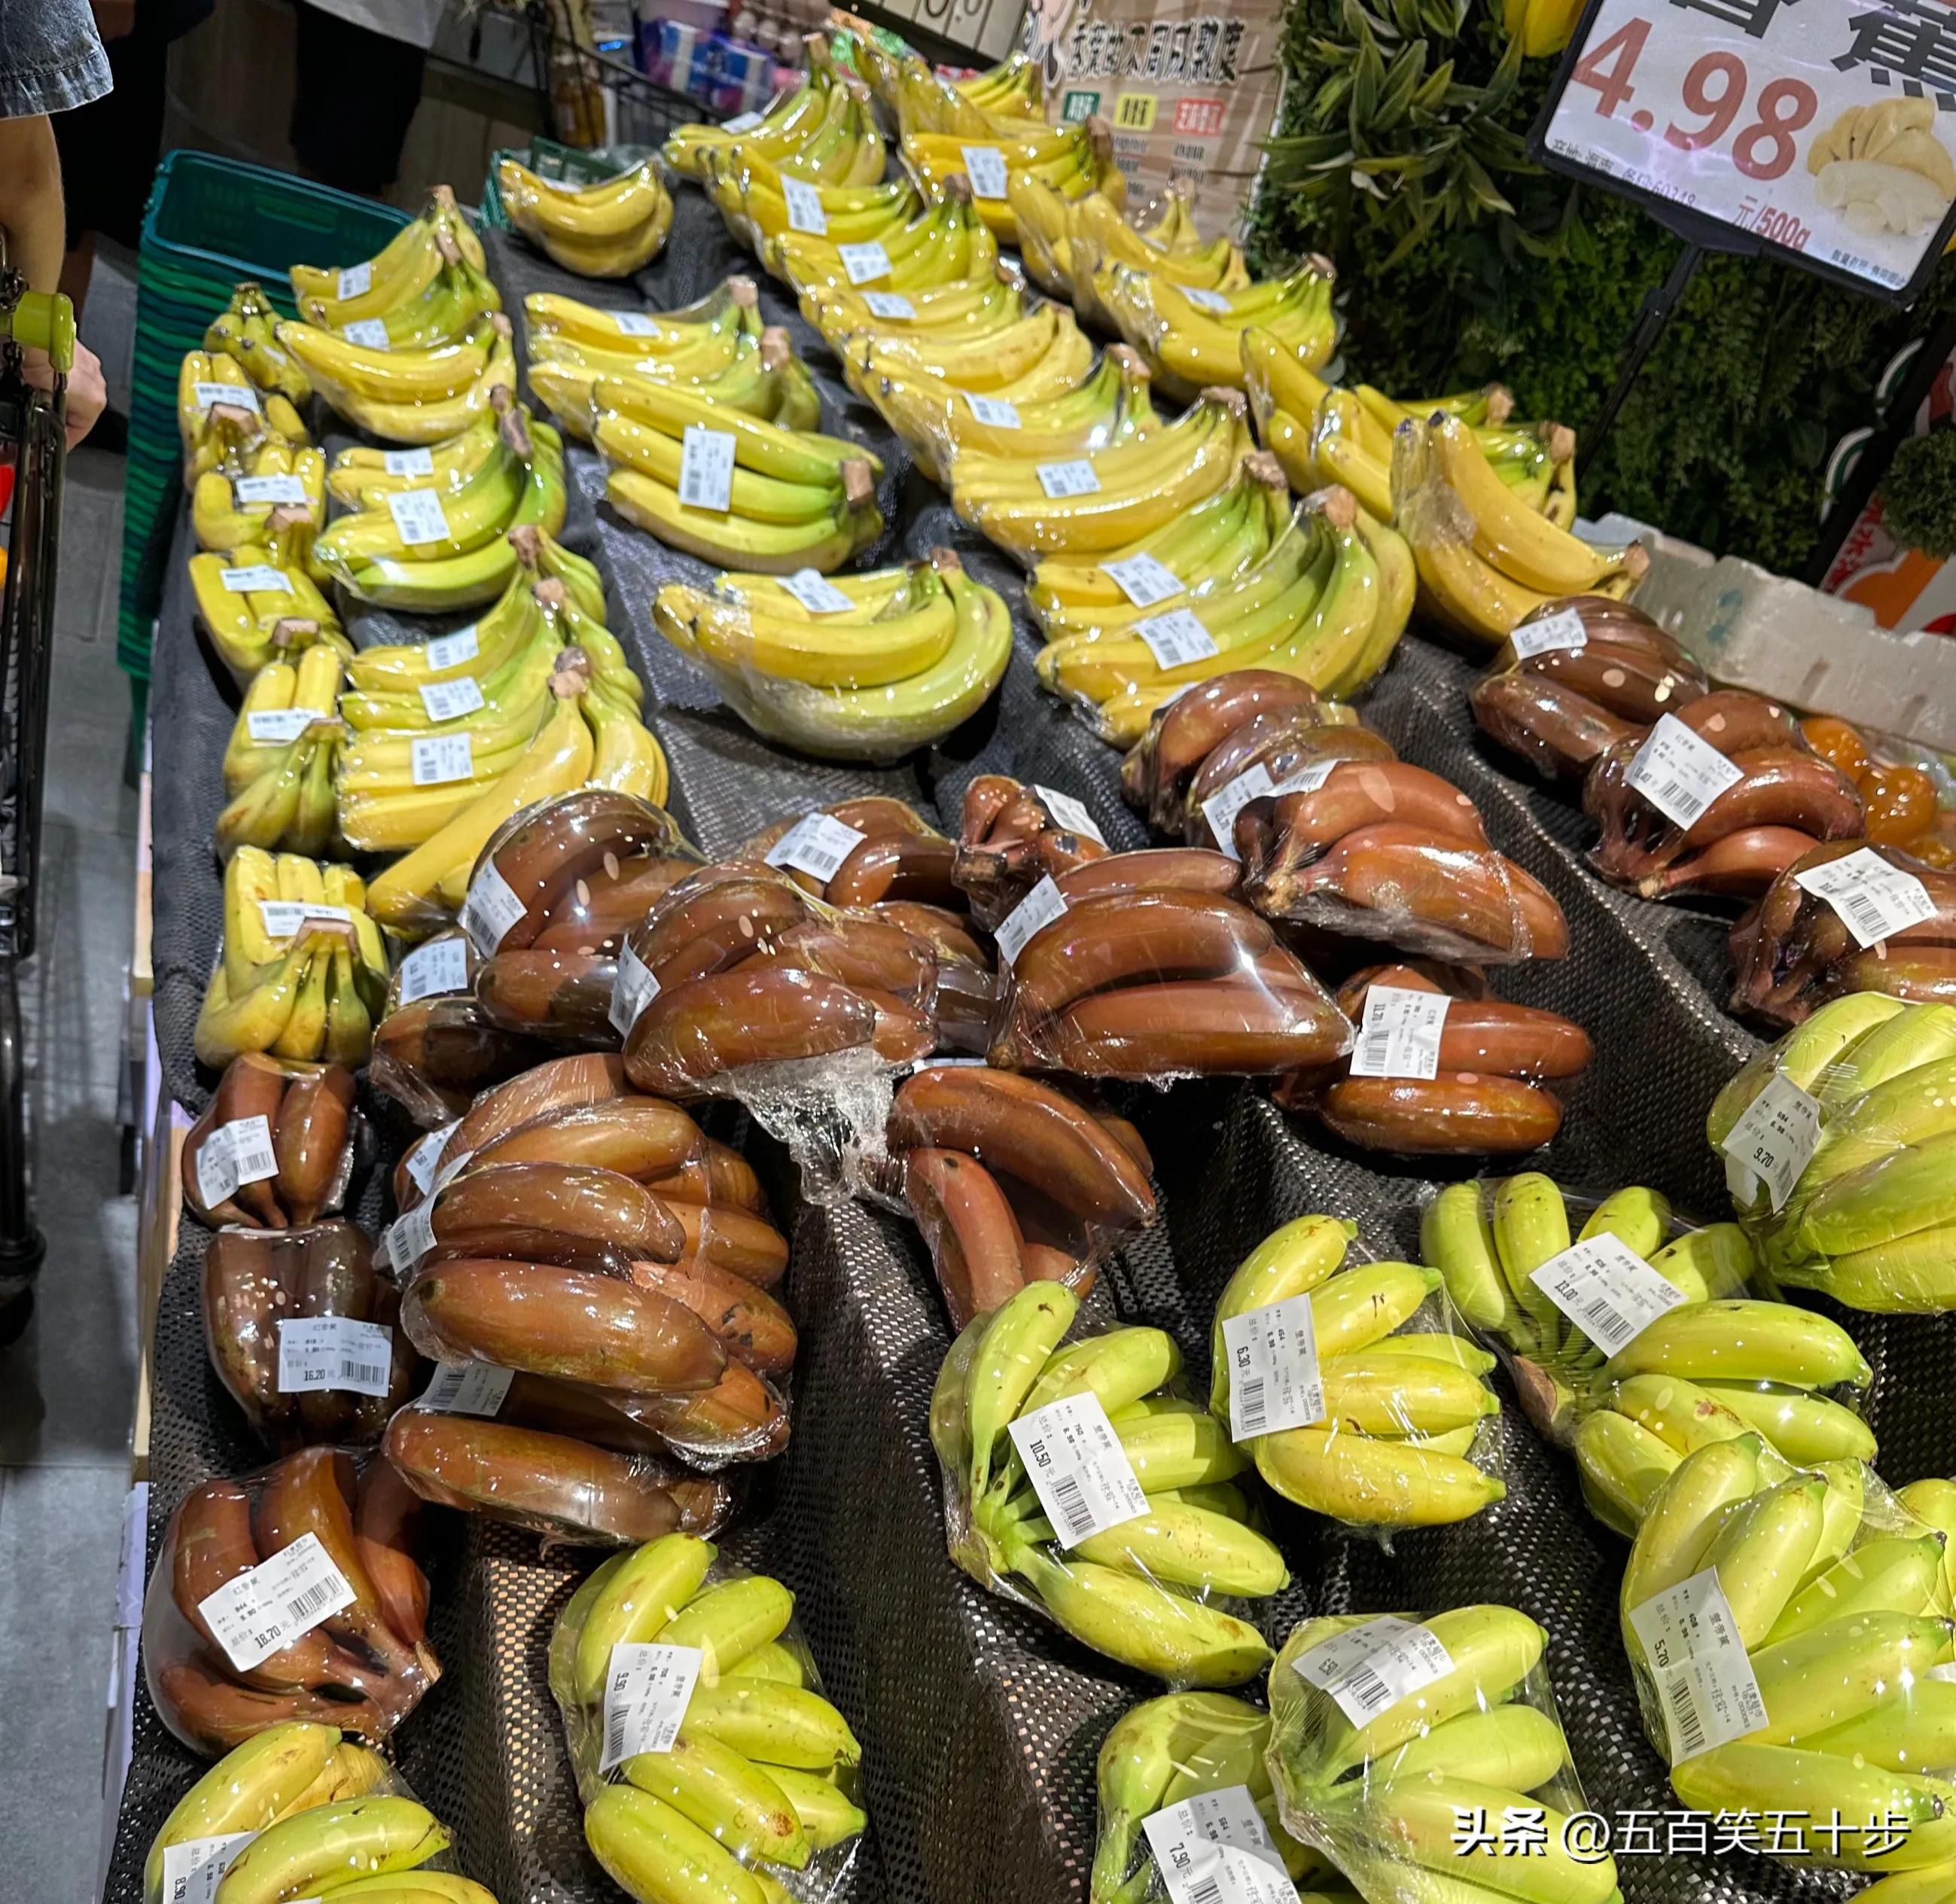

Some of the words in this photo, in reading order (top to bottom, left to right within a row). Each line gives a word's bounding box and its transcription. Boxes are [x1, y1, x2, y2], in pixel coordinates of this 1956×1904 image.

[1571, 17, 1818, 181] 4.98
[1753, 1144, 1773, 1169] 9.70
[1554, 1280, 1578, 1301] 13.00
[1237, 1346, 1251, 1367] 6.30
[304, 1369, 325, 1382] 16.20
[1038, 1416, 1053, 1439] 总价:
[1063, 1427, 1075, 1443] 6.98
[1075, 1424, 1083, 1436] 750
[1030, 1439, 1051, 1467] 10.50
[1045, 1467, 1056, 1478] 元
[1656, 1604, 1671, 1632] 总价:
[1679, 1618, 1689, 1638] 6.98
[1689, 1613, 1699, 1628] 408
[254, 1625, 281, 1649] 18.70
[1709, 1613, 1729, 1647] 皇帝蕉
[1654, 1639, 1669, 1667] 5.70
[1178, 1810, 1193, 1835] 总价:
[1205, 1821, 1218, 1840] 6.98
[1218, 1817, 1229, 1830] 564
[1169, 1842, 1190, 1869] 7.90
[1179, 1866, 1193, 1878] 元
[174, 1876, 187, 1901] 8.90
